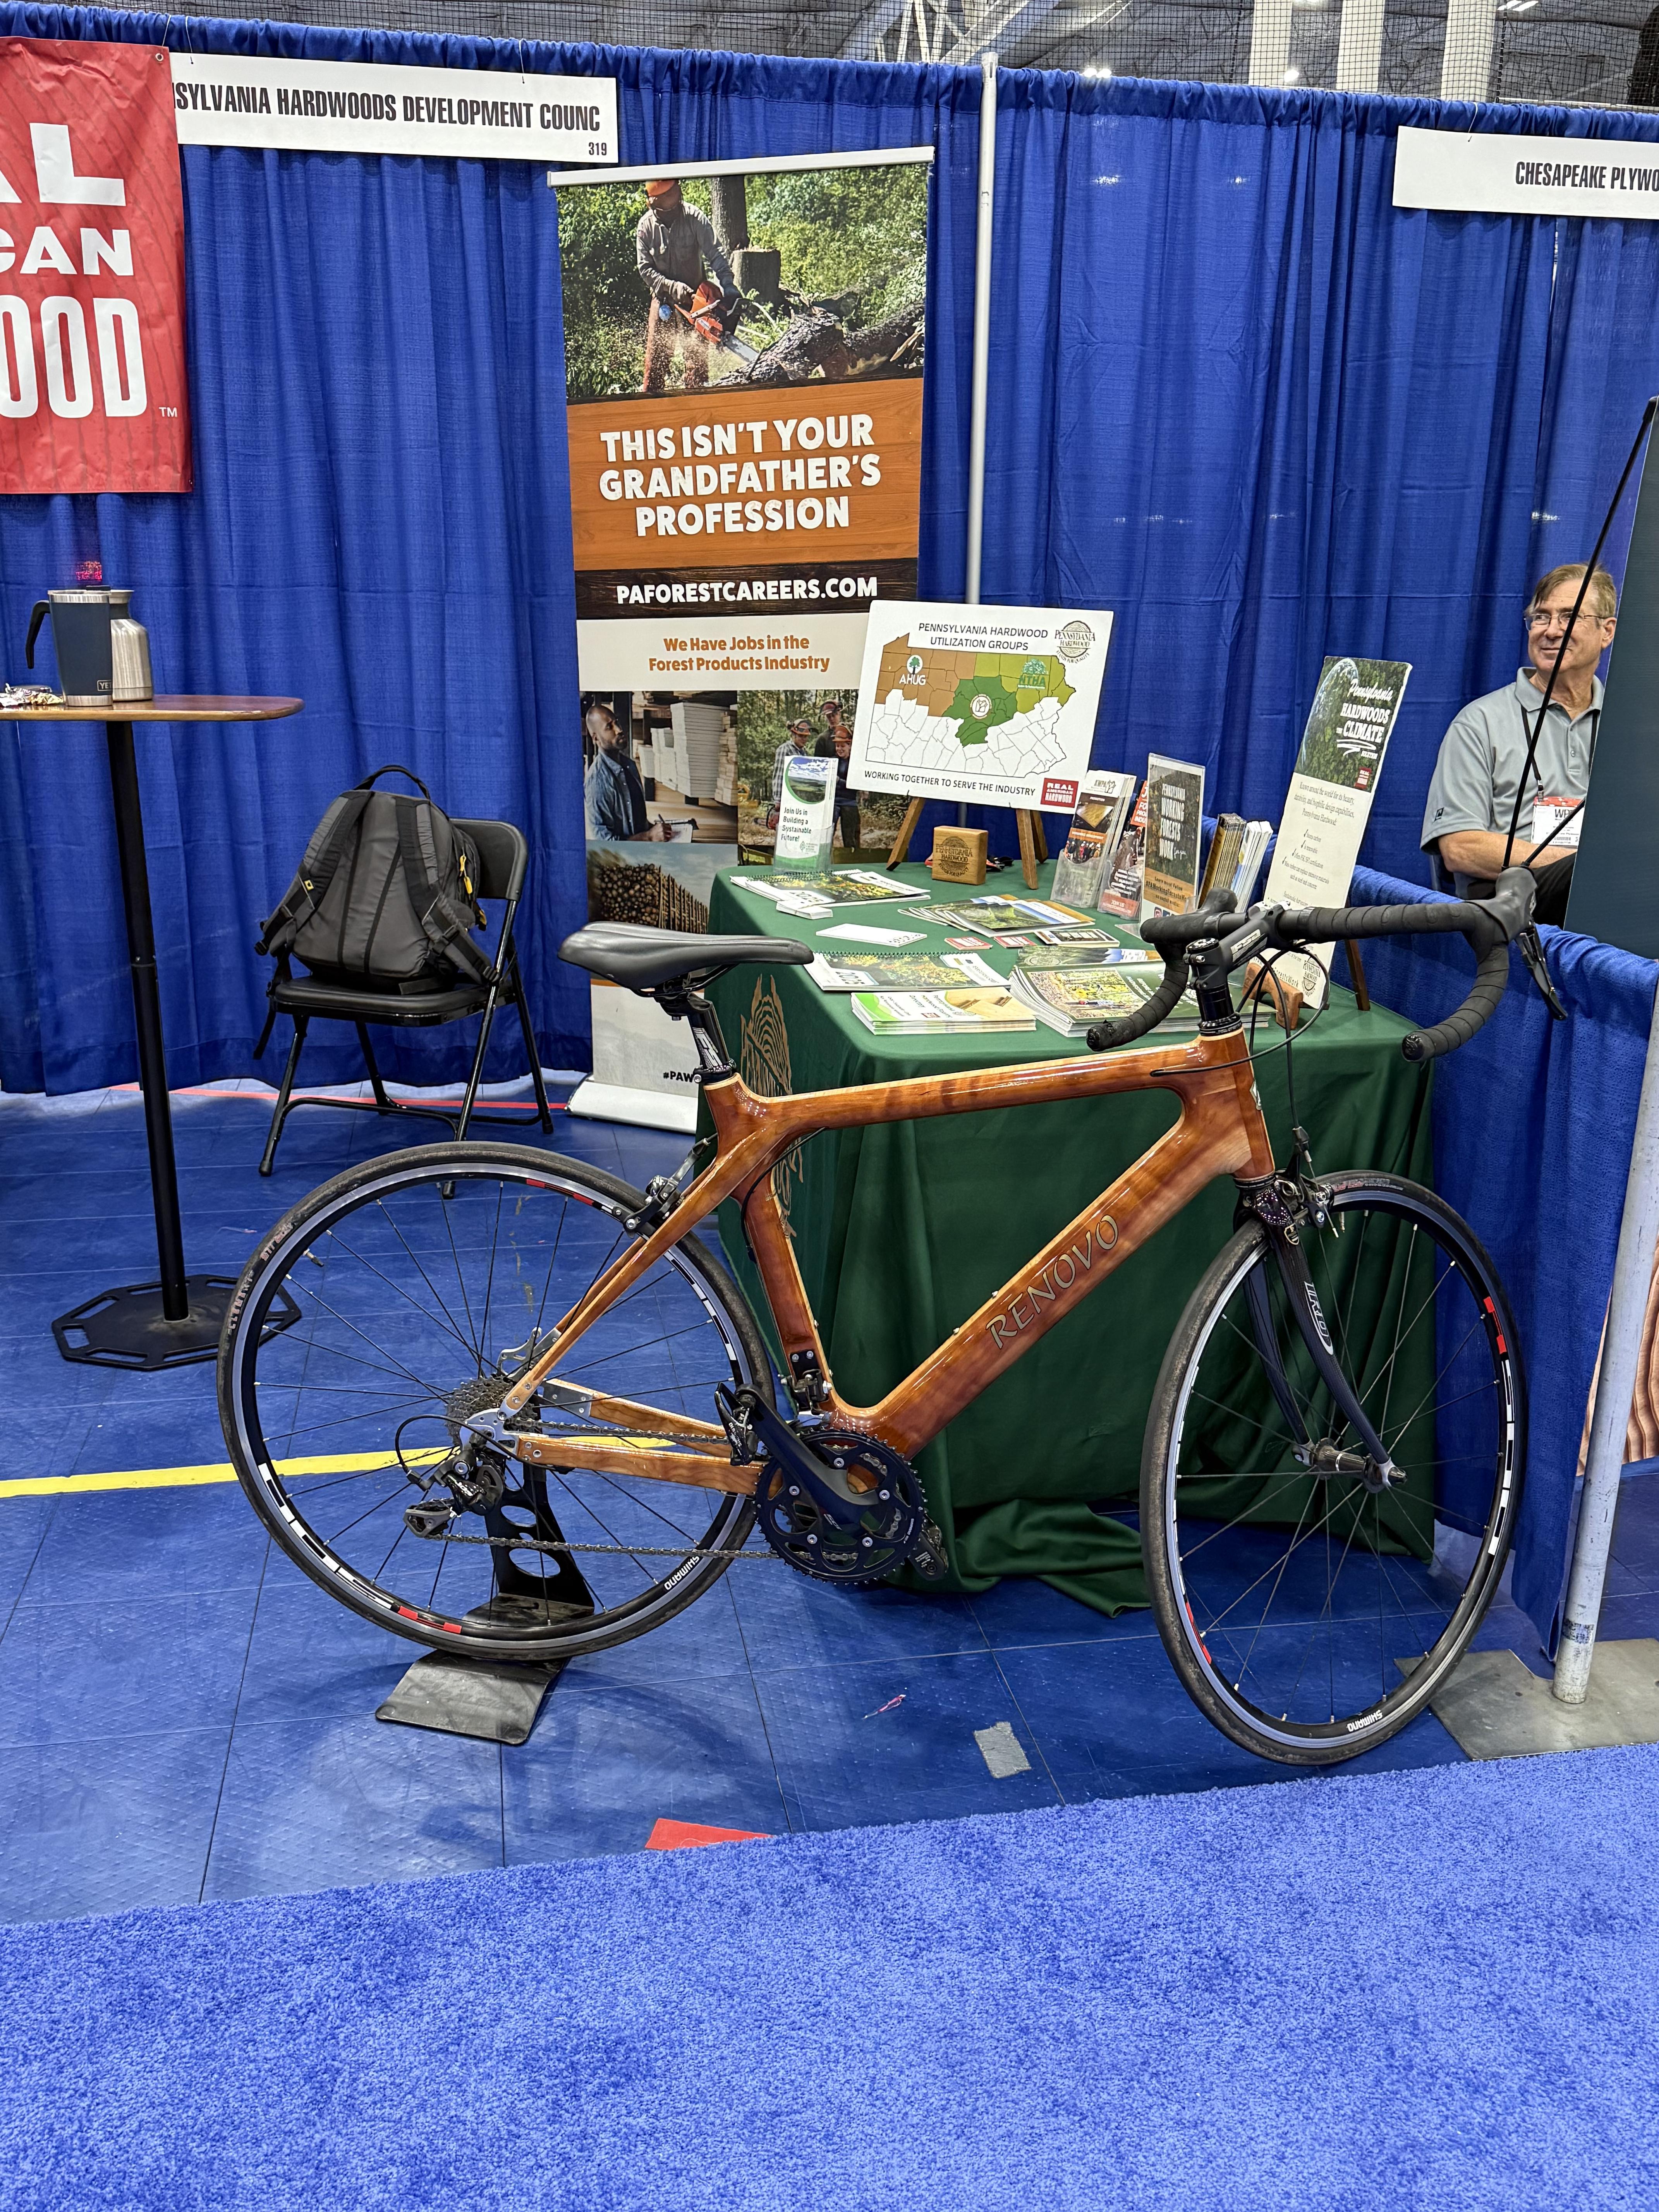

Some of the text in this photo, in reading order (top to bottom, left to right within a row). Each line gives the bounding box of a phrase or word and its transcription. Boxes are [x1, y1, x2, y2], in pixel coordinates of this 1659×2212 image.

[172, 82, 600, 131] SYLVANIA HARDWOODS DEVELOPMENT COUNC
[588, 142, 607, 156] 319
[0, 122, 126, 206] L
[1515, 161, 1607, 189] CHESAPEAKE
[159, 407, 178, 417] TM
[600, 414, 875, 462] THIS ISN'T YOUR
[599, 453, 882, 501] GRANDFATHER'S
[636, 496, 850, 537] PROFESSION
[617, 577, 878, 605] PAFORESTCAREERS.COM
[918, 623, 1048, 639] PENNSYLVANIA HARDWOOD
[663, 635, 810, 652] We Have Jobs in the
[930, 636, 1029, 651] UTILIZATION GROUPS
[649, 655, 830, 673] Forest Products Industry
[899, 674, 926, 686] AHUG
[1019, 675, 1046, 687] NTHA
[1346, 678, 1393, 704] Pennsylvania
[1340, 702, 1391, 724] HARDWOODS
[1343, 720, 1385, 744] CLIMATE
[864, 770, 1036, 797] WORKING TOGETHER TO SERVE THE INDUSTRY
[1047, 782, 1074, 791] REAL
[1045, 792, 1072, 804] HARDWOOD
[1161, 797, 1185, 822] WORKING
[782, 825, 812, 834] Sustainable
[783, 816, 804, 826] Building
[1160, 817, 1181, 842] FORESTS
[781, 833, 800, 842] Future!
[1159, 838, 1174, 861] WORK
[835, 971, 866, 984] 2025
[986, 1214, 1119, 1350] RENOVO
[664, 1555, 700, 1591] SHIMANO
[1346, 1708, 1383, 1733] SHIMANO
